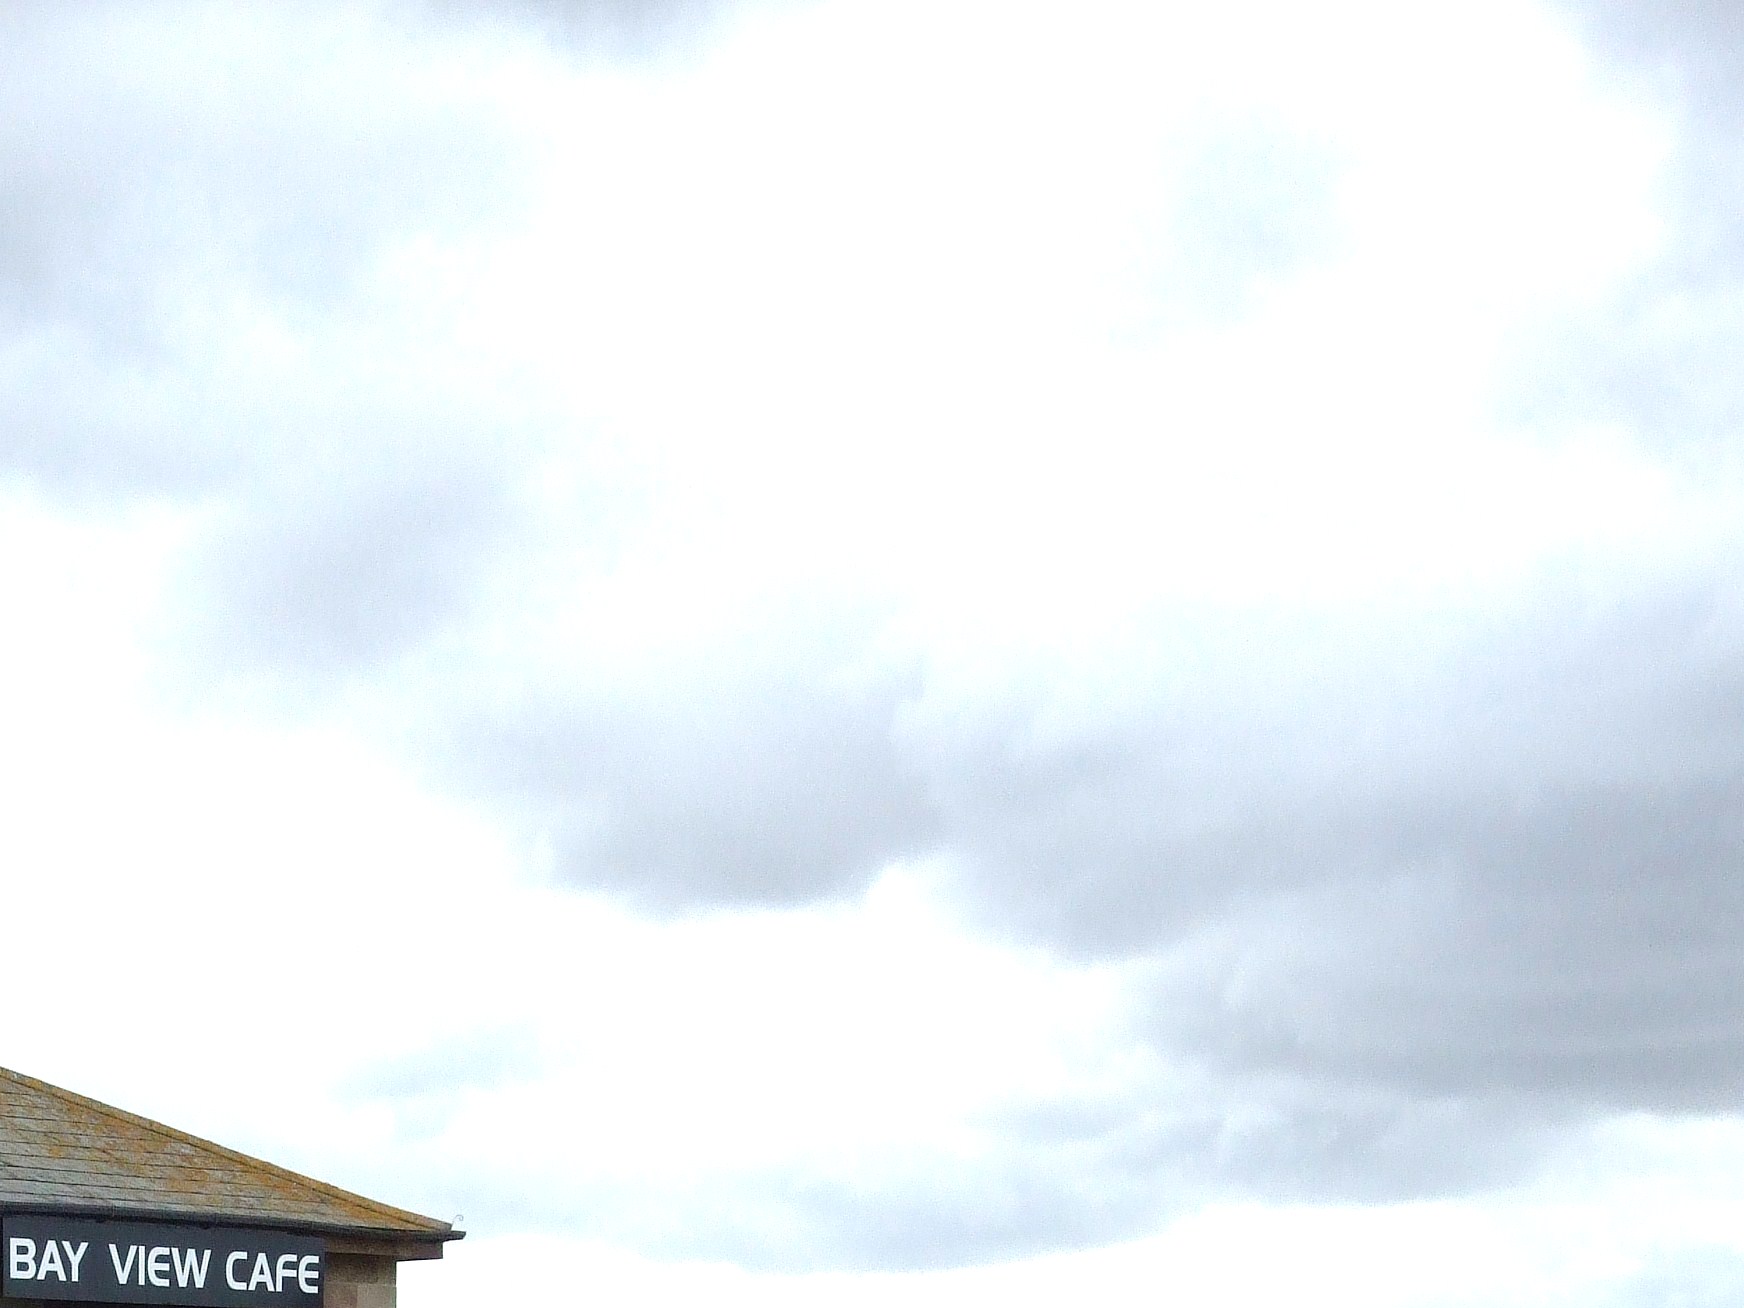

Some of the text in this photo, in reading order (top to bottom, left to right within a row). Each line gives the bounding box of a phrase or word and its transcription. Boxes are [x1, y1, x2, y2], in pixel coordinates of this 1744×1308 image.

[8, 1236, 321, 1294] BAY VIEW CAFE
